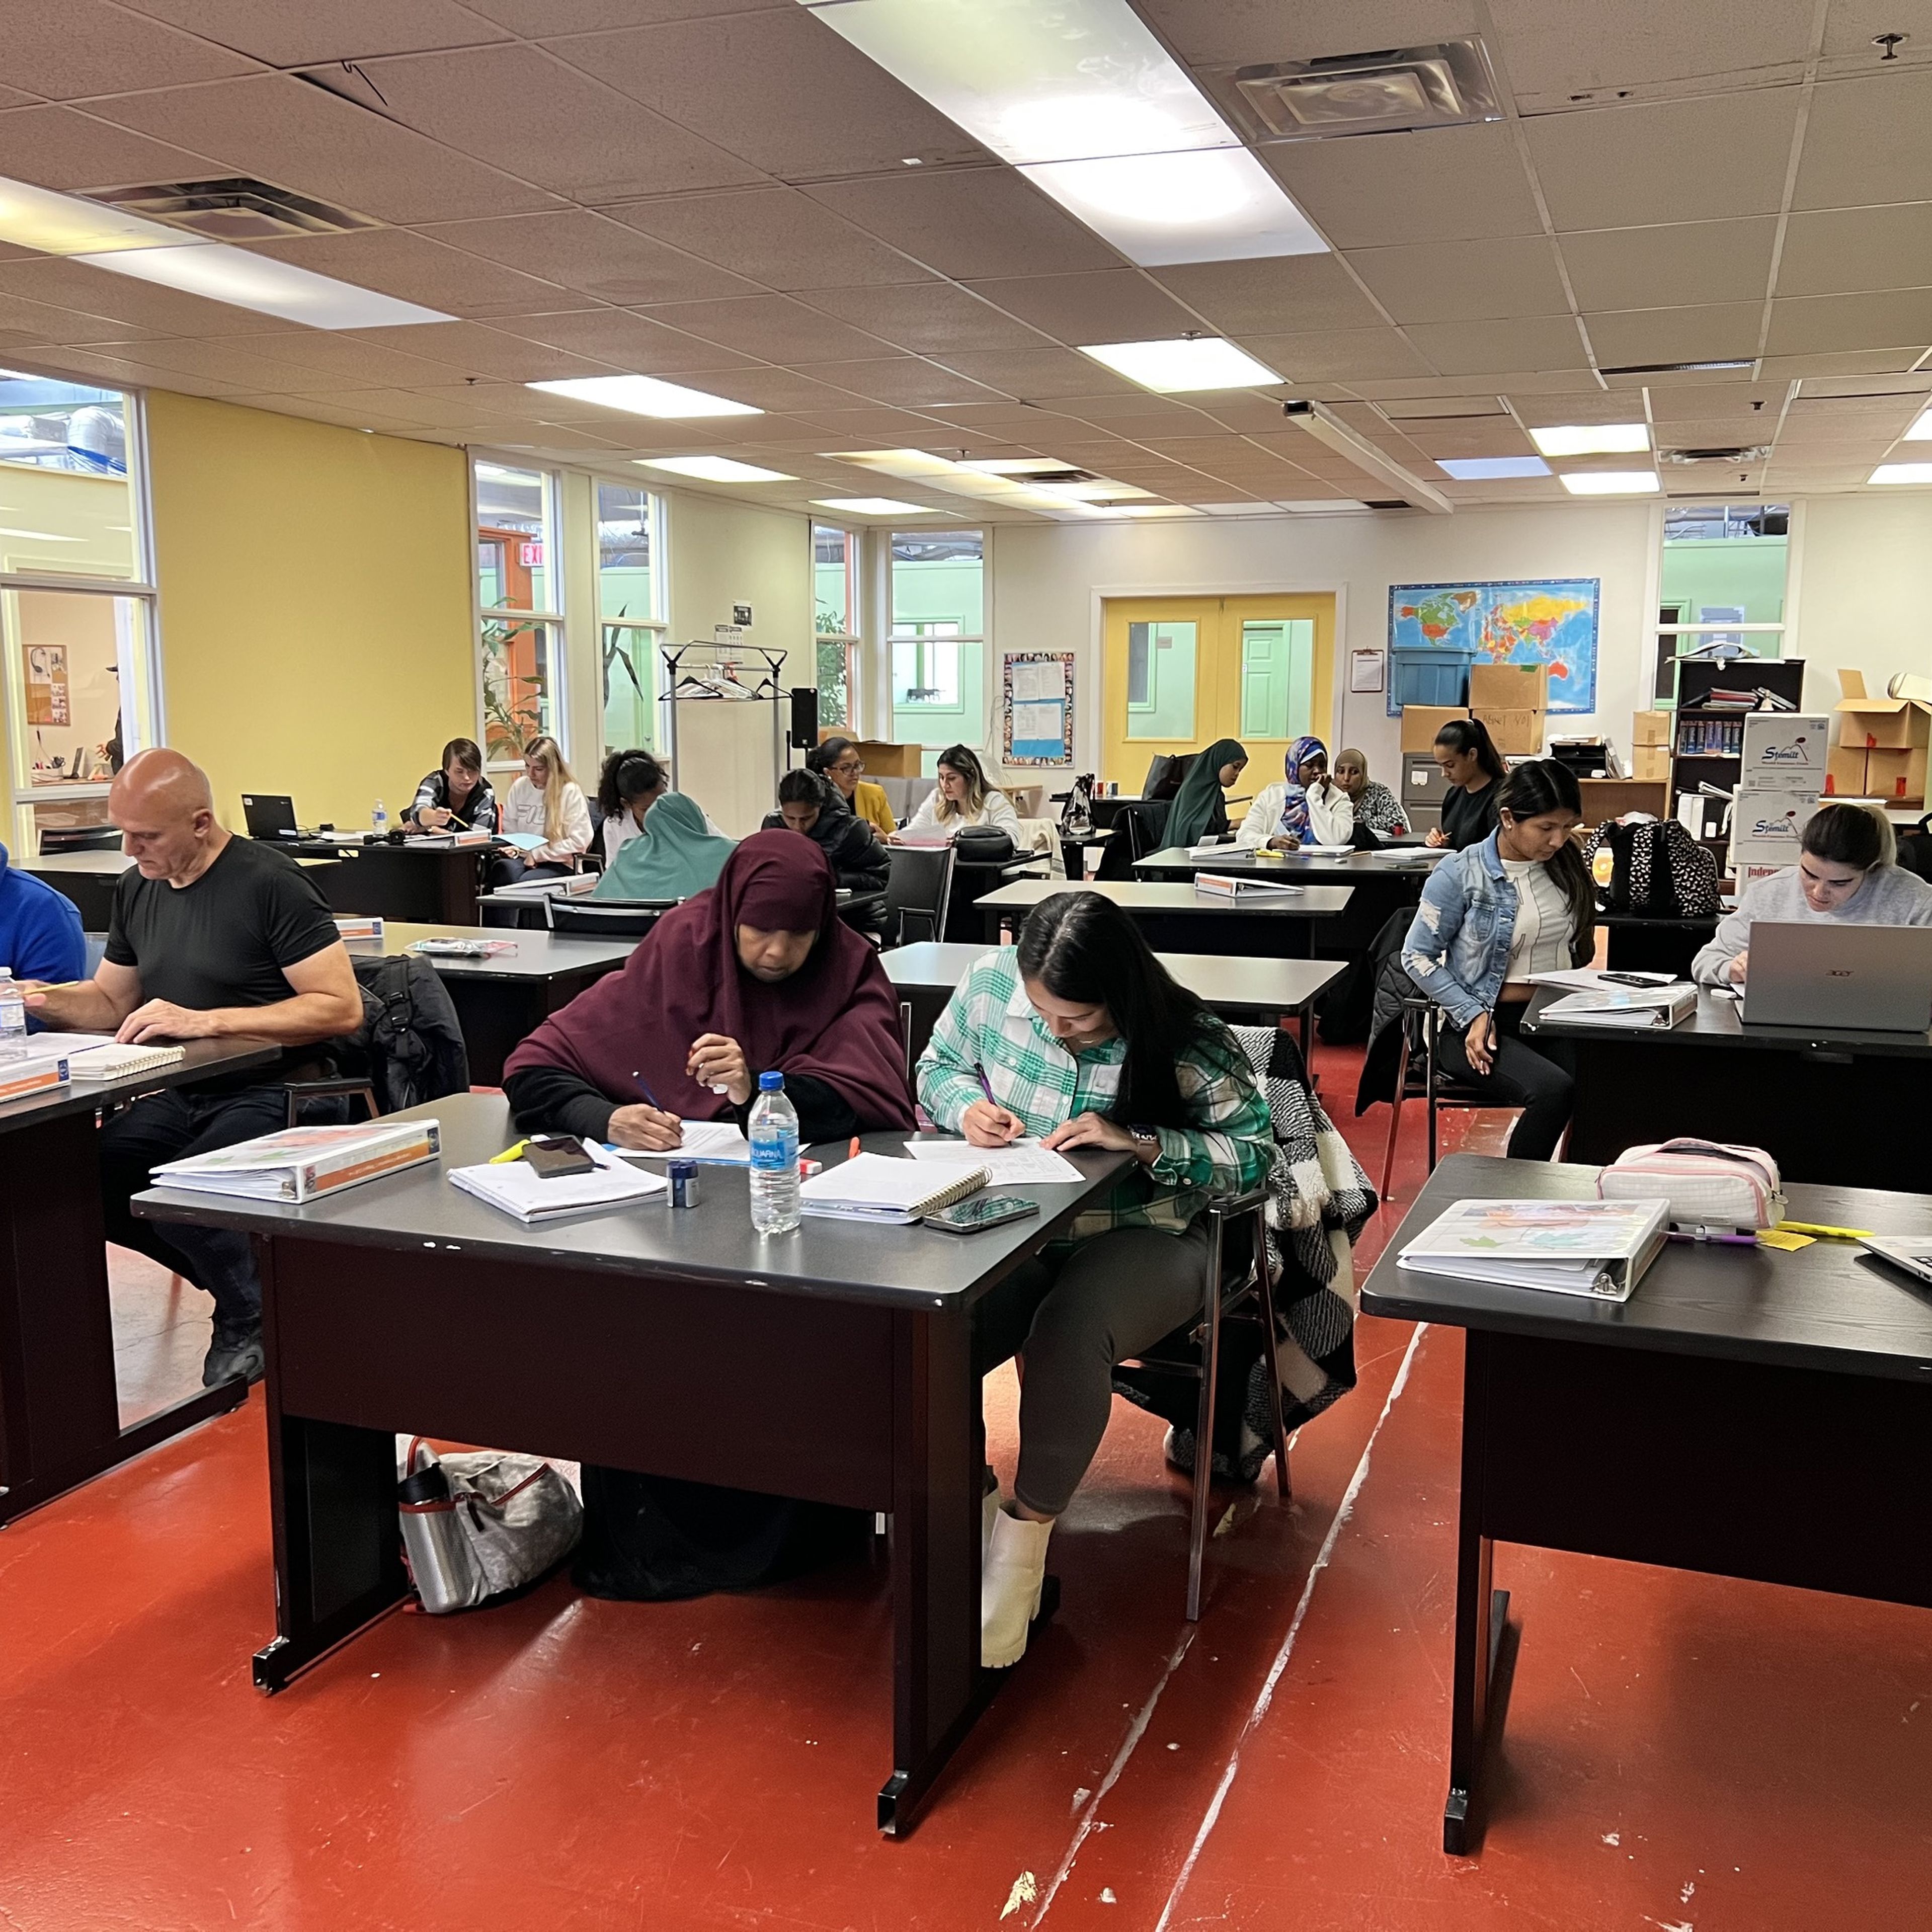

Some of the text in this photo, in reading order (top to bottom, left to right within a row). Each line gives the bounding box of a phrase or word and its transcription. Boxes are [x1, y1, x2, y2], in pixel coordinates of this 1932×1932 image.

[523, 545, 542, 564] EXI
[1761, 747, 1800, 761] Stemilt
[517, 804, 545, 825] FIL
[1752, 820, 1789, 834] Stemilt
